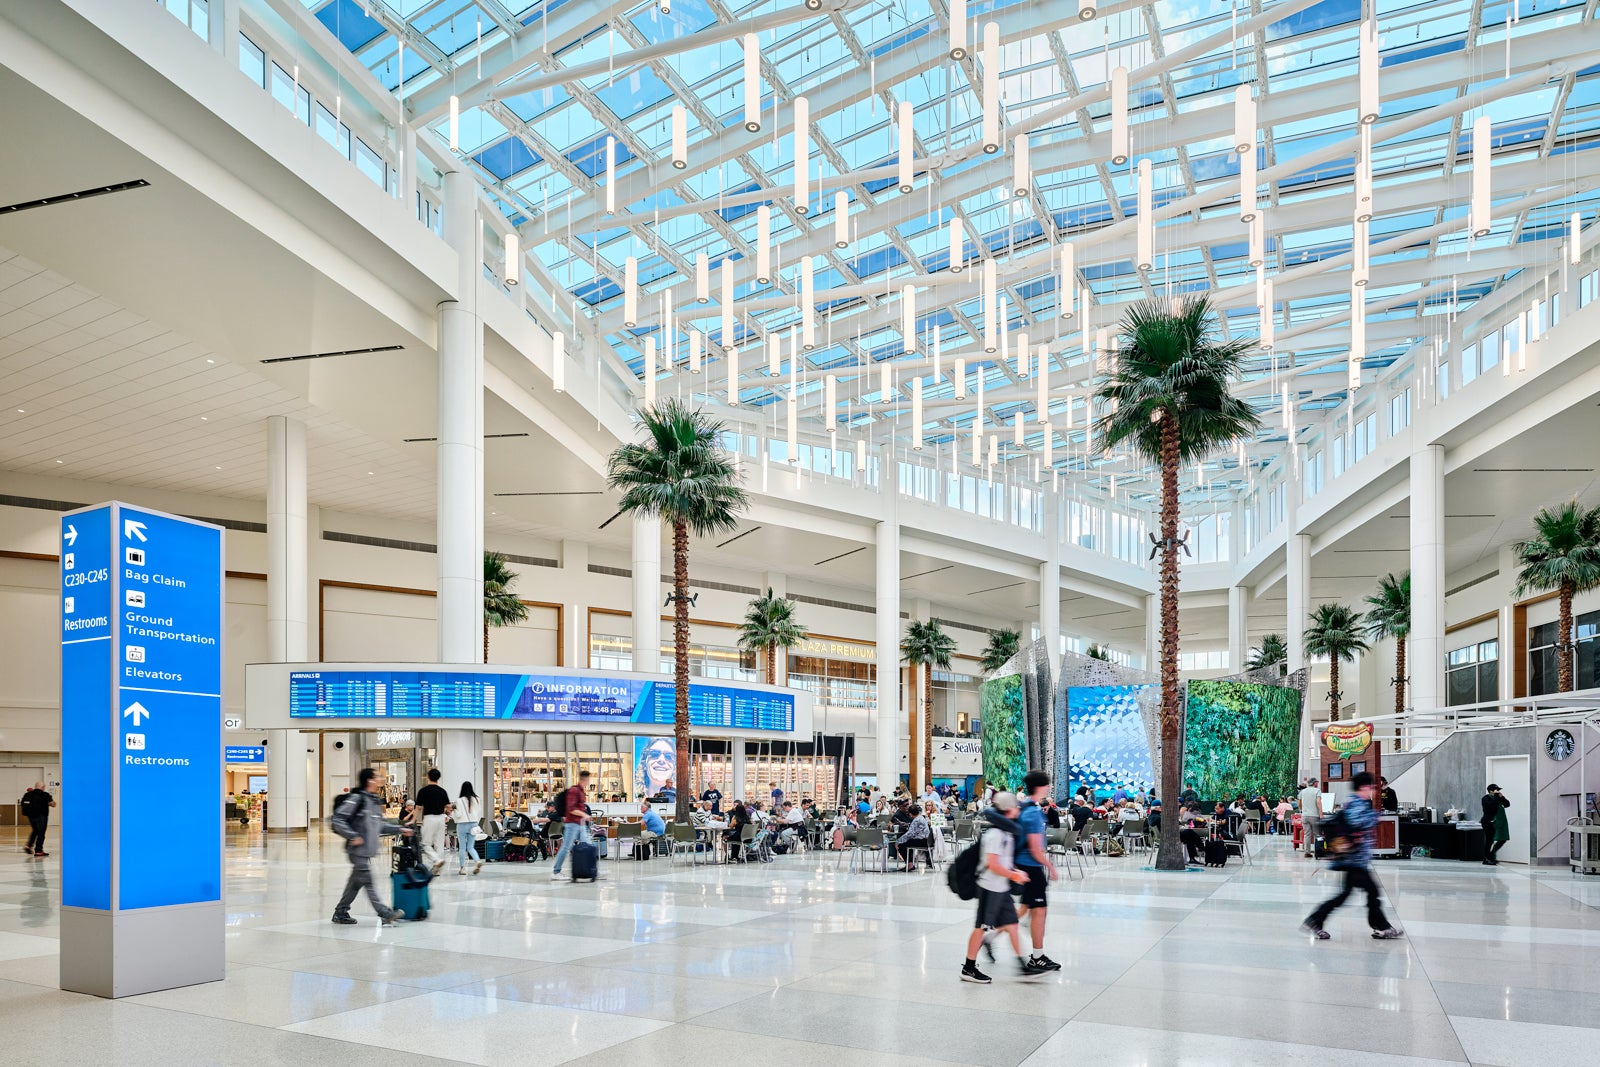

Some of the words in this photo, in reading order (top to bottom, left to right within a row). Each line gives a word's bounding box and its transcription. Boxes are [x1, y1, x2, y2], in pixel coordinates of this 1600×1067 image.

[64, 568, 108, 587] C230-C245
[125, 569, 149, 584] Bag
[152, 574, 186, 588] Claim
[64, 616, 108, 631] Restrooms
[125, 611, 173, 627] Ground
[125, 624, 216, 645] Transportation
[793, 639, 827, 654] PLAZA
[830, 643, 874, 659] PREMIUM
[125, 666, 183, 682] Elevators
[546, 684, 627, 696] INFORMATION
[593, 705, 609, 713] 4:48
[125, 755, 190, 766] Restrooms
